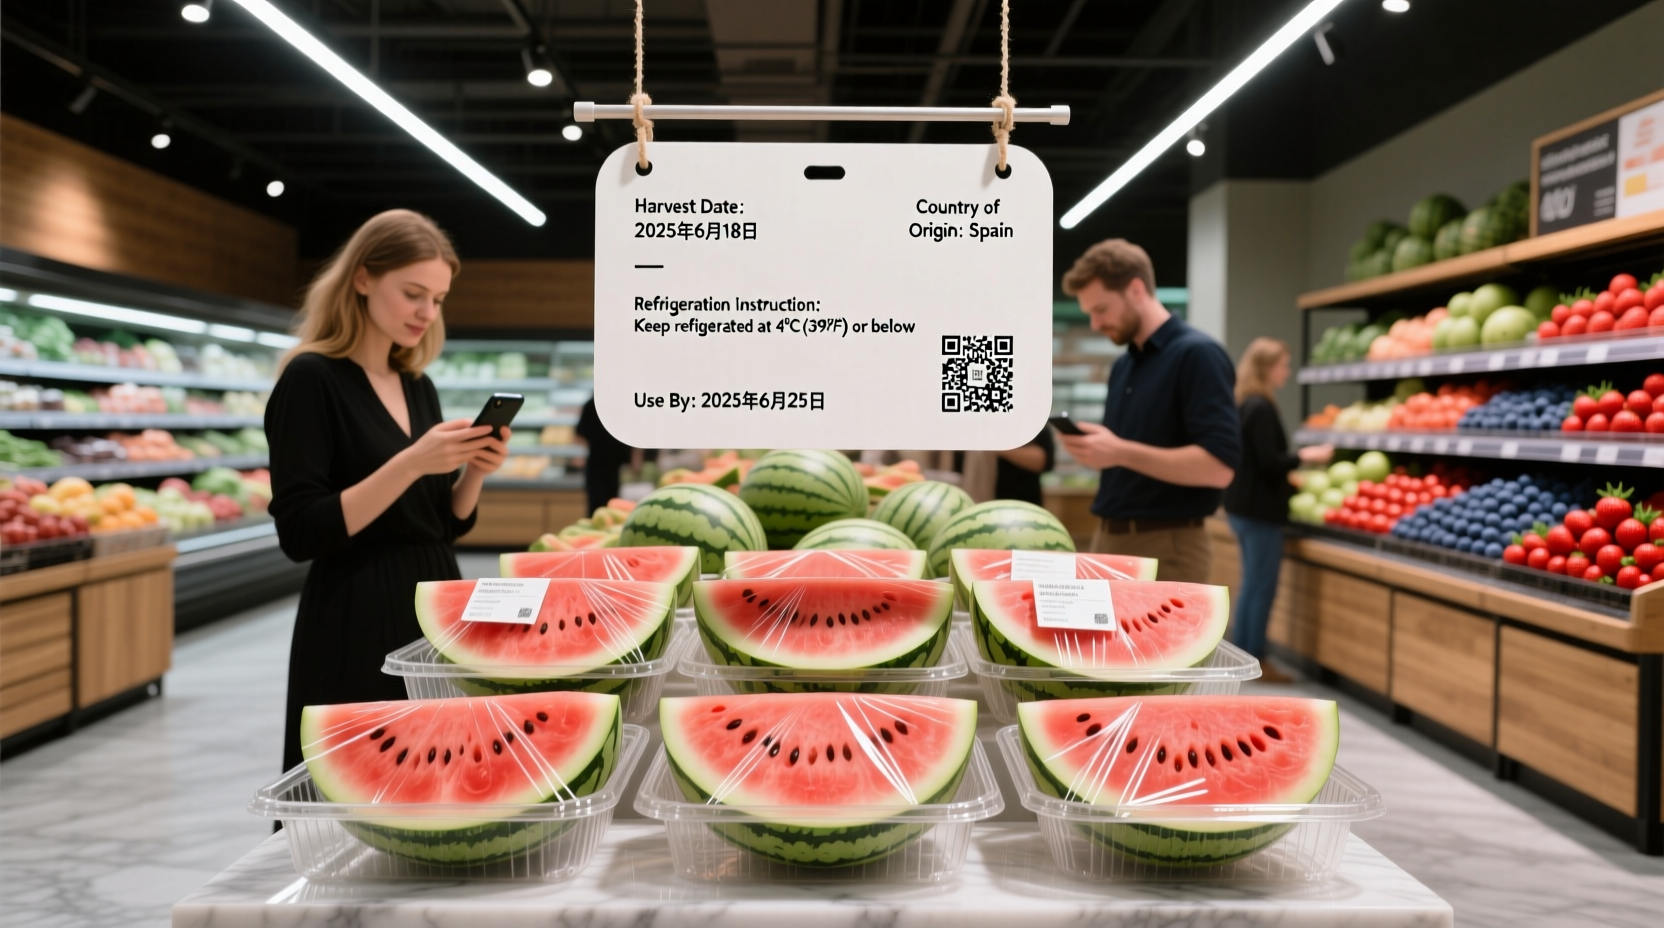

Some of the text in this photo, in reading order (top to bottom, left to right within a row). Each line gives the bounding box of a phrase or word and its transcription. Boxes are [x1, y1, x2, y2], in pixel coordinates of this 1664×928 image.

[635, 198, 744, 215] Harvest Date:
[915, 198, 1001, 219] Country of
[634, 221, 757, 241] 2025年6月18日
[908, 221, 1014, 243] Origin: Spain
[634, 296, 821, 317] Refrigeration Instruction:
[634, 317, 671, 337] Keep
[674, 317, 754, 337] refigerated
[757, 320, 772, 333] at
[852, 322, 869, 333] or
[871, 317, 916, 334] below
[634, 391, 825, 414] Use By: 2025年6月25日
